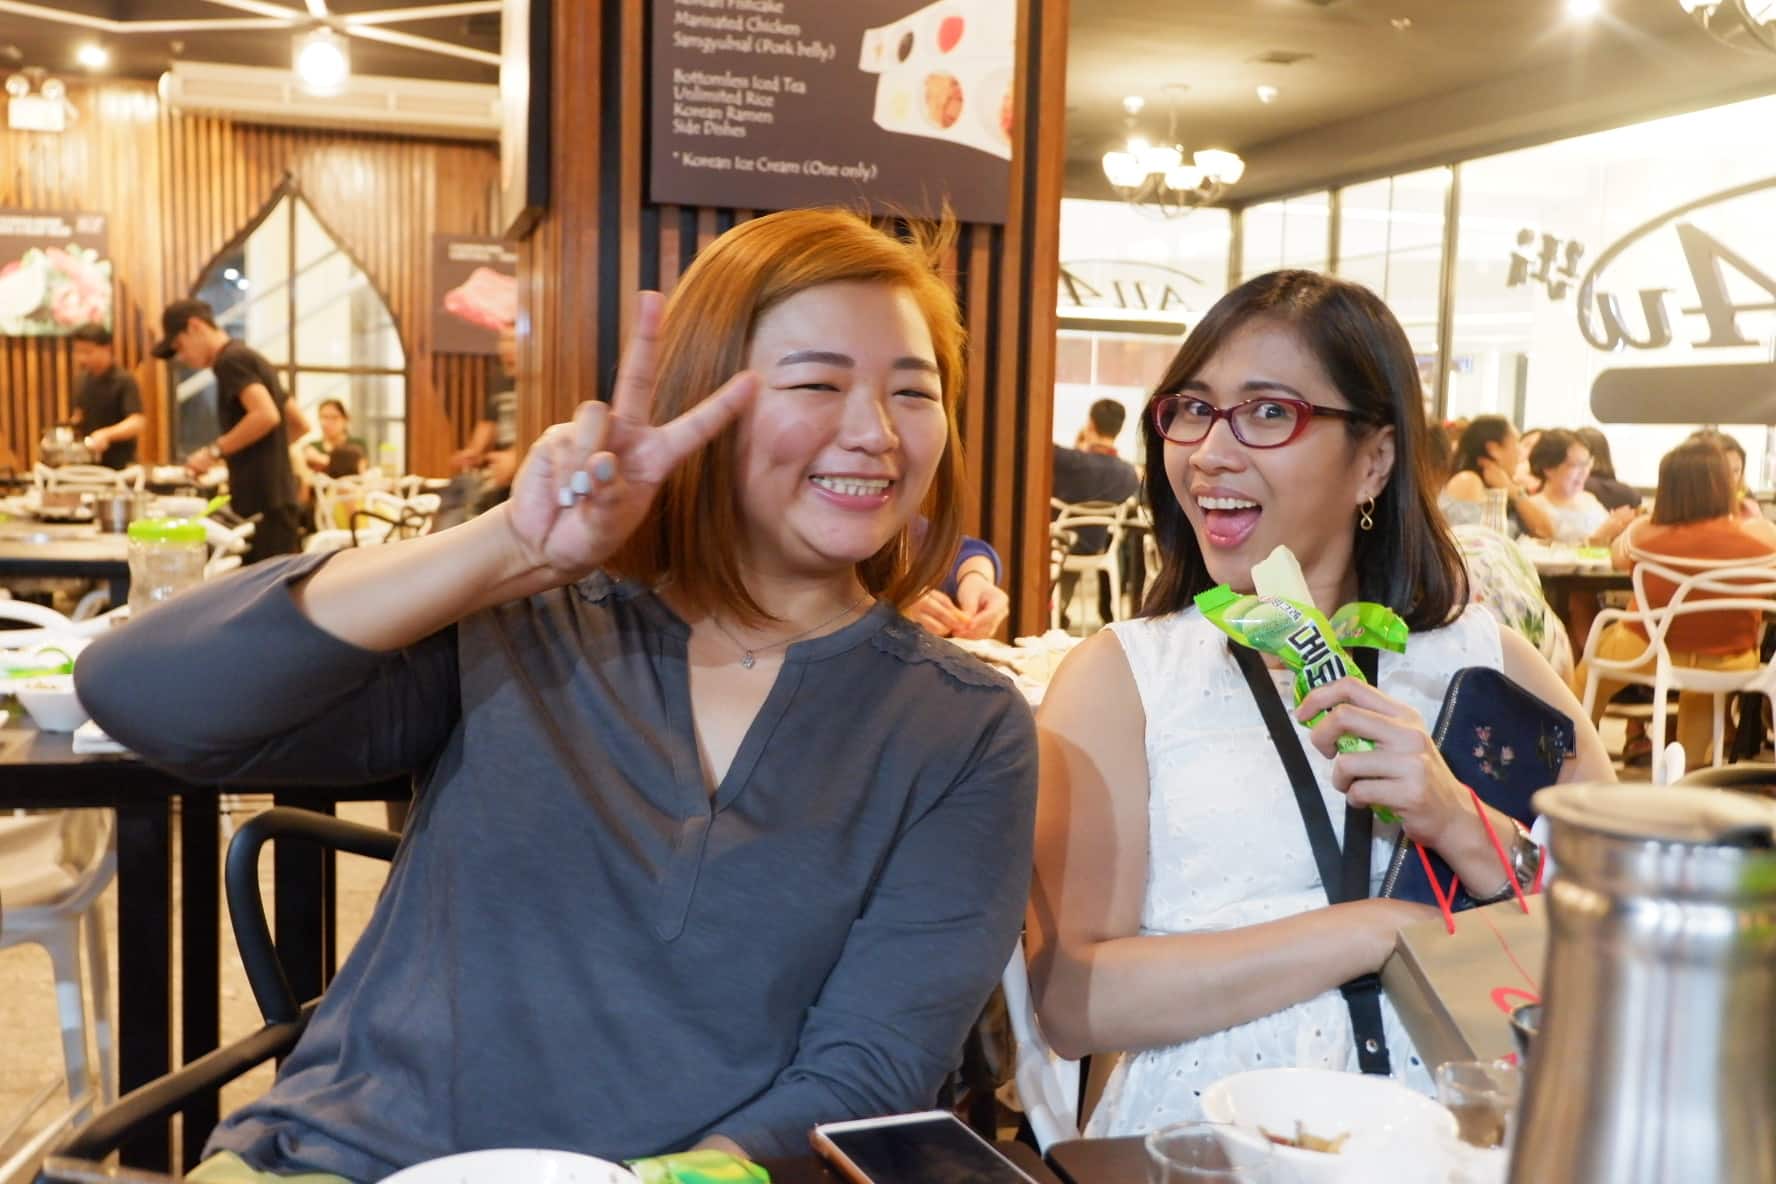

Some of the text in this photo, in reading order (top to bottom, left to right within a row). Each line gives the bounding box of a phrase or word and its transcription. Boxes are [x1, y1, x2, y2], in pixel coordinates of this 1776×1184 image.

[746, 15, 801, 36] Chicken
[755, 38, 796, 56] (Pork
[673, 69, 807, 95] Bottomless Iced Tea
[673, 87, 775, 108] Unlimited Rice
[673, 103, 774, 124] Korean Ramen
[673, 119, 747, 138] Side Dishes
[682, 152, 878, 183] Korean Ice Cream (One only)
[1287, 623, 1347, 690] 메로
